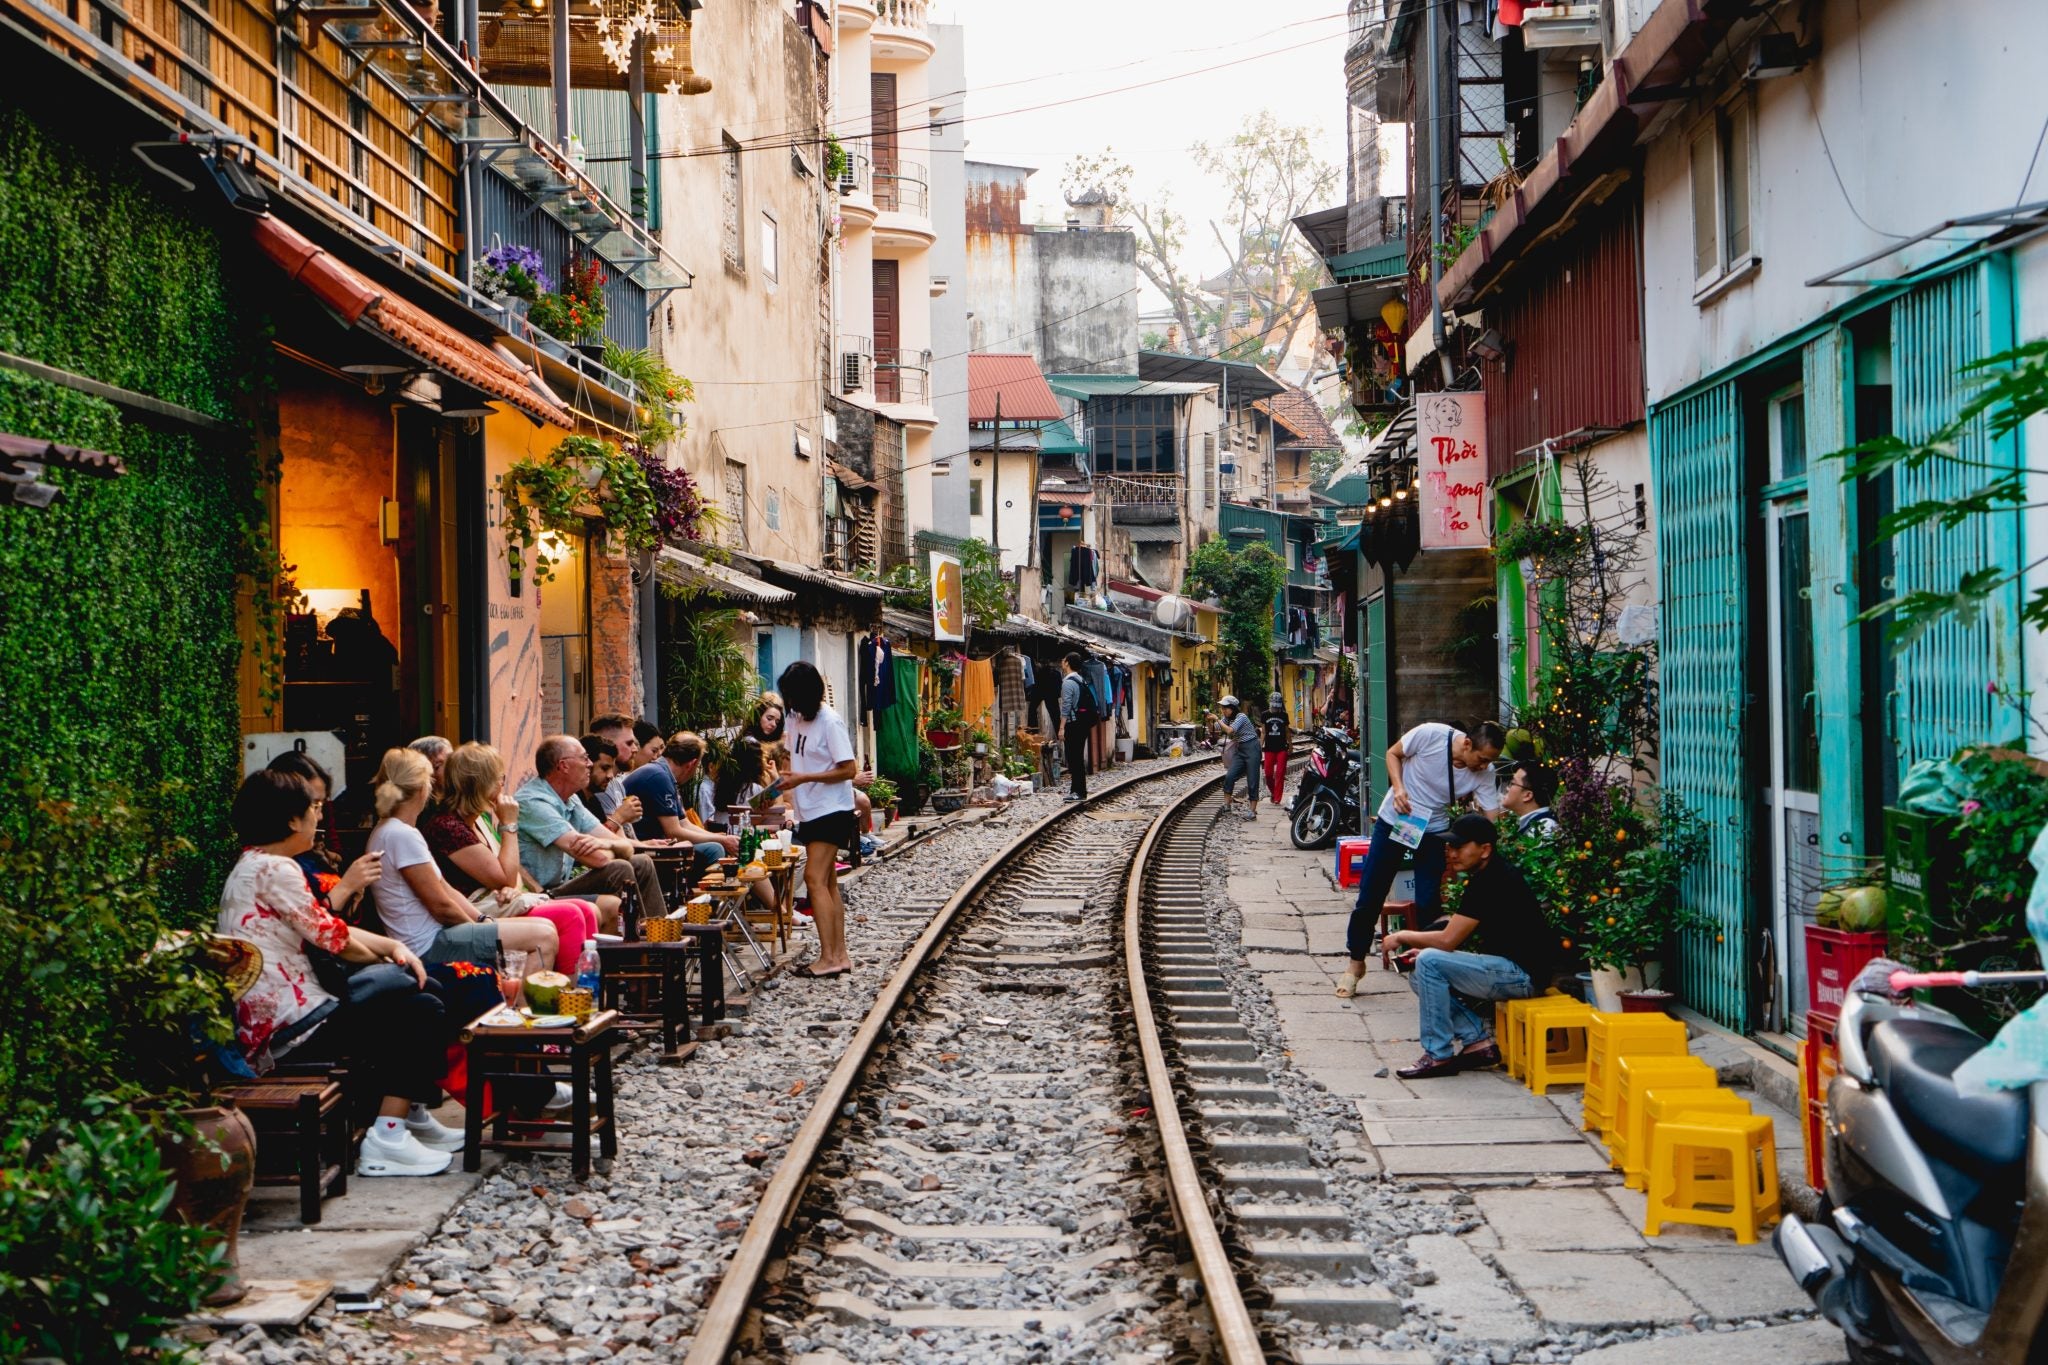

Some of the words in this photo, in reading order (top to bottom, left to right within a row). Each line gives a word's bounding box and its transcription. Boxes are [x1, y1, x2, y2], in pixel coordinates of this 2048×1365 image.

[1431, 437, 1478, 465] Thời
[1427, 472, 1483, 519] Trang
[1433, 507, 1469, 536] Tóc
[665, 794, 674, 809] 5
